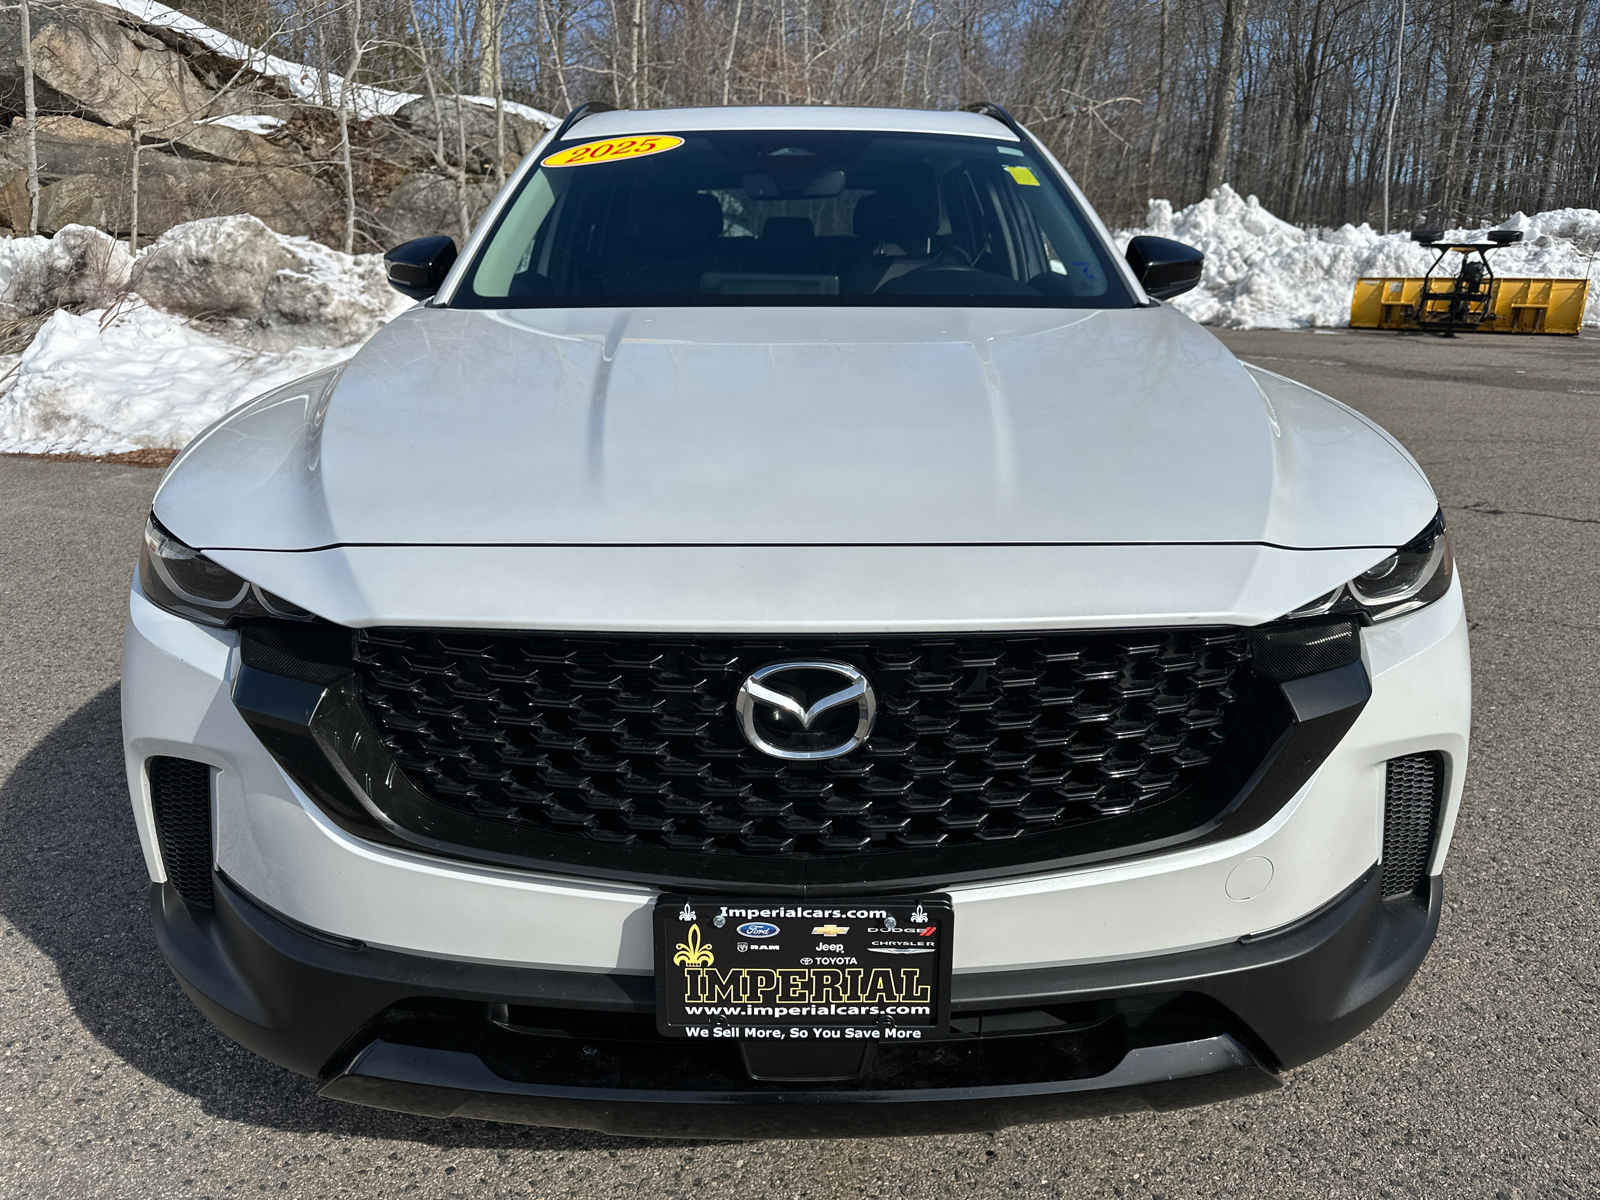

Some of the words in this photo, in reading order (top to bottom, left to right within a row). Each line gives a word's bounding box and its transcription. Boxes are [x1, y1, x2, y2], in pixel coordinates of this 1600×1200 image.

[565, 138, 661, 164] 2025
[720, 907, 887, 920] Imperialcars.com
[746, 925, 770, 935] Ford
[815, 942, 844, 953] Jeep
[815, 957, 858, 965] TOYOTA
[685, 968, 931, 1003] IMPERIAL
[685, 1004, 931, 1017] www.imperialcars.com
[685, 1027, 710, 1038] We
[713, 1027, 740, 1038] Sell
[744, 1027, 786, 1039] More,
[789, 1028, 809, 1039] So
[812, 1028, 841, 1039] You
[845, 1028, 881, 1039] Save
[885, 1028, 922, 1039] More
